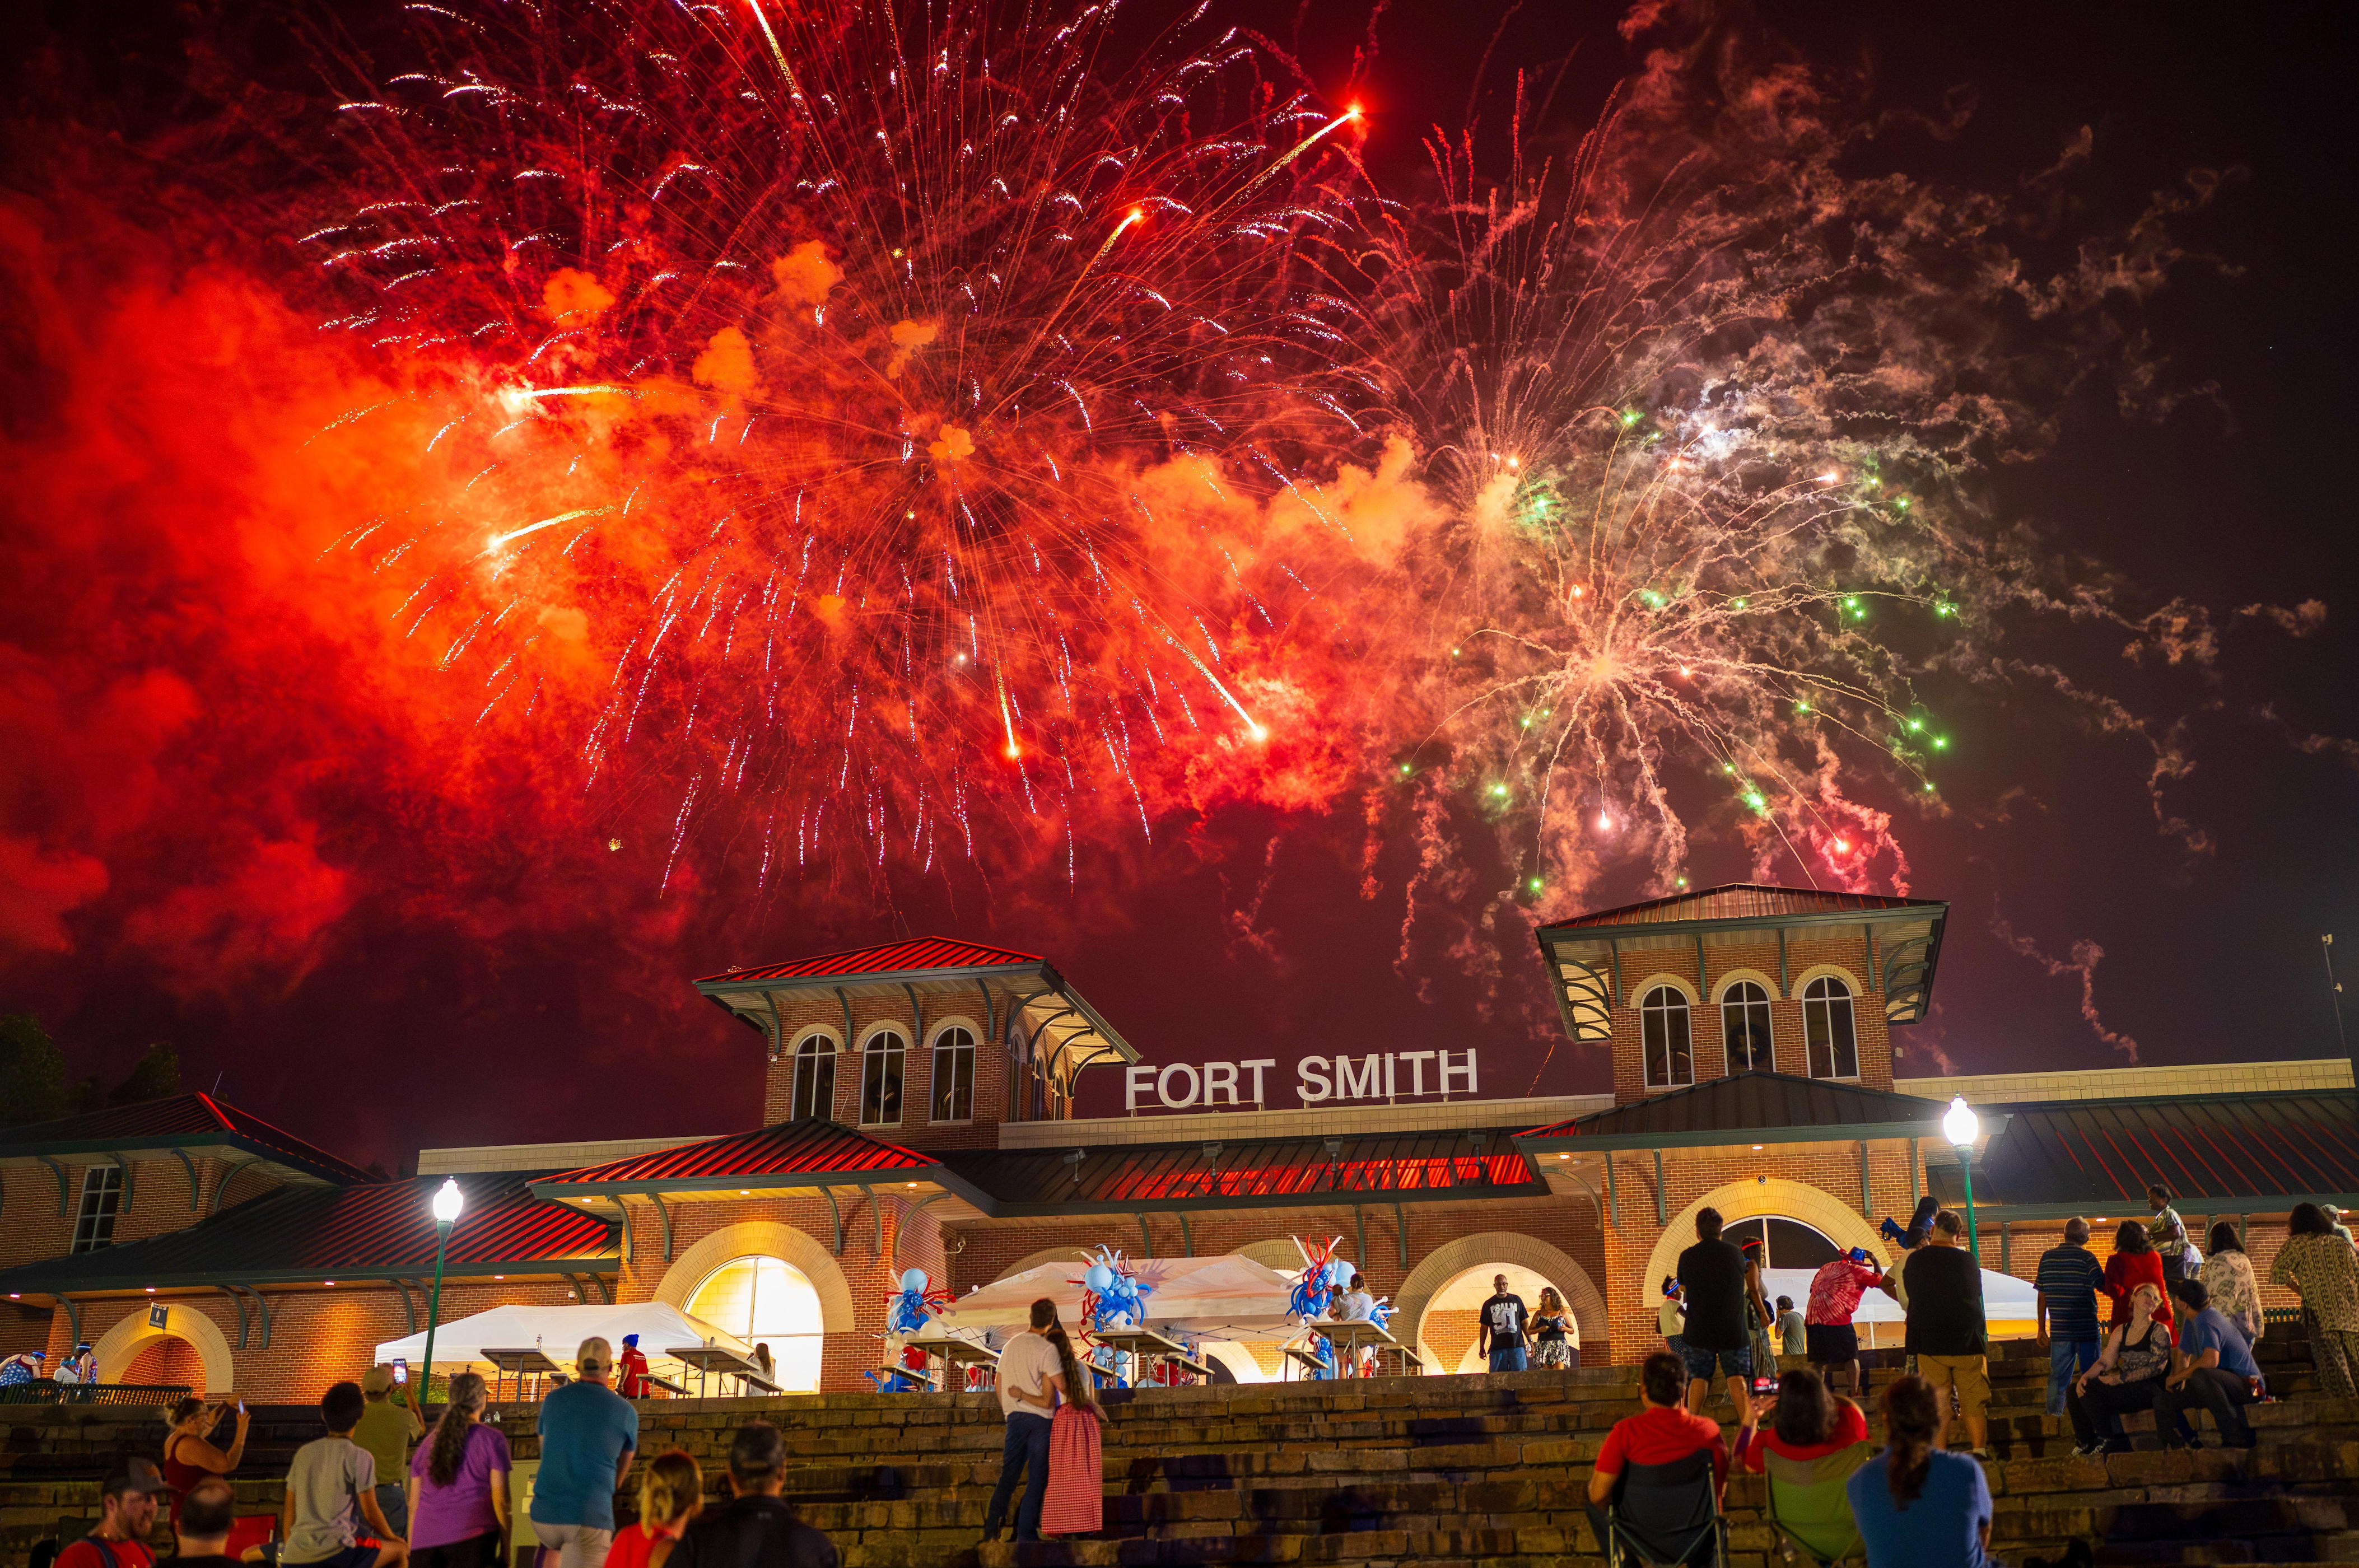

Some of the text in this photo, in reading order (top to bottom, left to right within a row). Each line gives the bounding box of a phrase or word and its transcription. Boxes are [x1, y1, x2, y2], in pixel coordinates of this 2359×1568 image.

[1126, 1048, 1477, 1110] FORT SMITH
[1490, 1303, 1517, 1314] PSALM
[1492, 1310, 1517, 1332] 91
